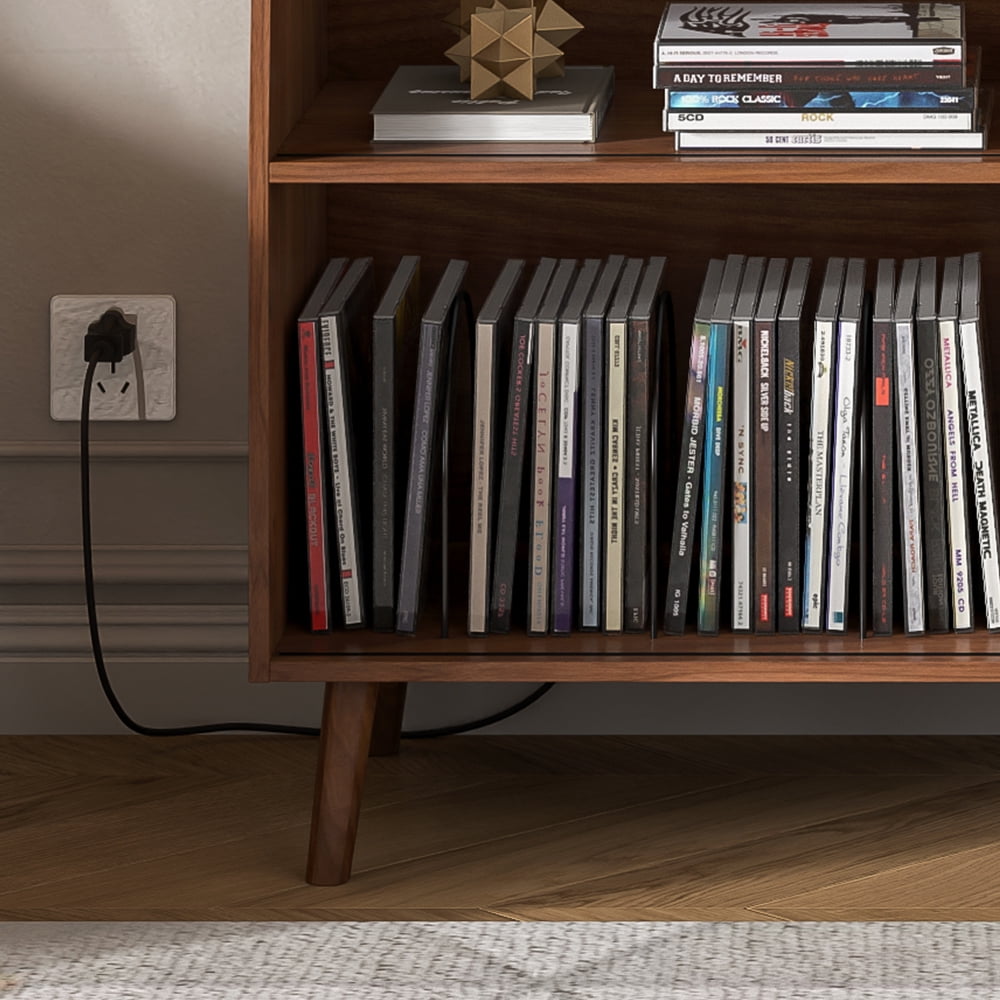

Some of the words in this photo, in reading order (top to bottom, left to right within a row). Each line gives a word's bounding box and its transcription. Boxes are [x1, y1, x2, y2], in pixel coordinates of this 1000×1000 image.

[673, 73, 681, 84] A
[683, 73, 705, 84] DAY
[708, 73, 722, 84] TO
[723, 73, 783, 84] REMEMBER
[711, 95, 739, 104] ROCK
[741, 95, 781, 104] CLASSIC
[678, 114, 705, 122] 5CD
[801, 113, 834, 122] ROCK
[775, 136, 789, 144] CENT
[760, 330, 769, 377] NICKELBACK
[943, 338, 952, 388] METALLICA
[760, 382, 769, 405] SILVER
[760, 407, 769, 421] SIDE
[840, 396, 851, 423] Olga
[968, 390, 981, 450] METALLICA
[760, 423, 769, 431] UP
[947, 409, 955, 445] ANGELS
[816, 430, 824, 449] THE
[687, 437, 697, 473] JESTER
[814, 452, 824, 515] MASTERPLAN
[975, 460, 986, 497] DEATH
[683, 481, 692, 507] Gates
[309, 493, 318, 546] BLACKOUT
[682, 510, 689, 519] to
[678, 521, 688, 556] Valhalla
[979, 501, 991, 559] MAGNETIC
[955, 549, 962, 565] MM
[958, 598, 965, 612] CD
